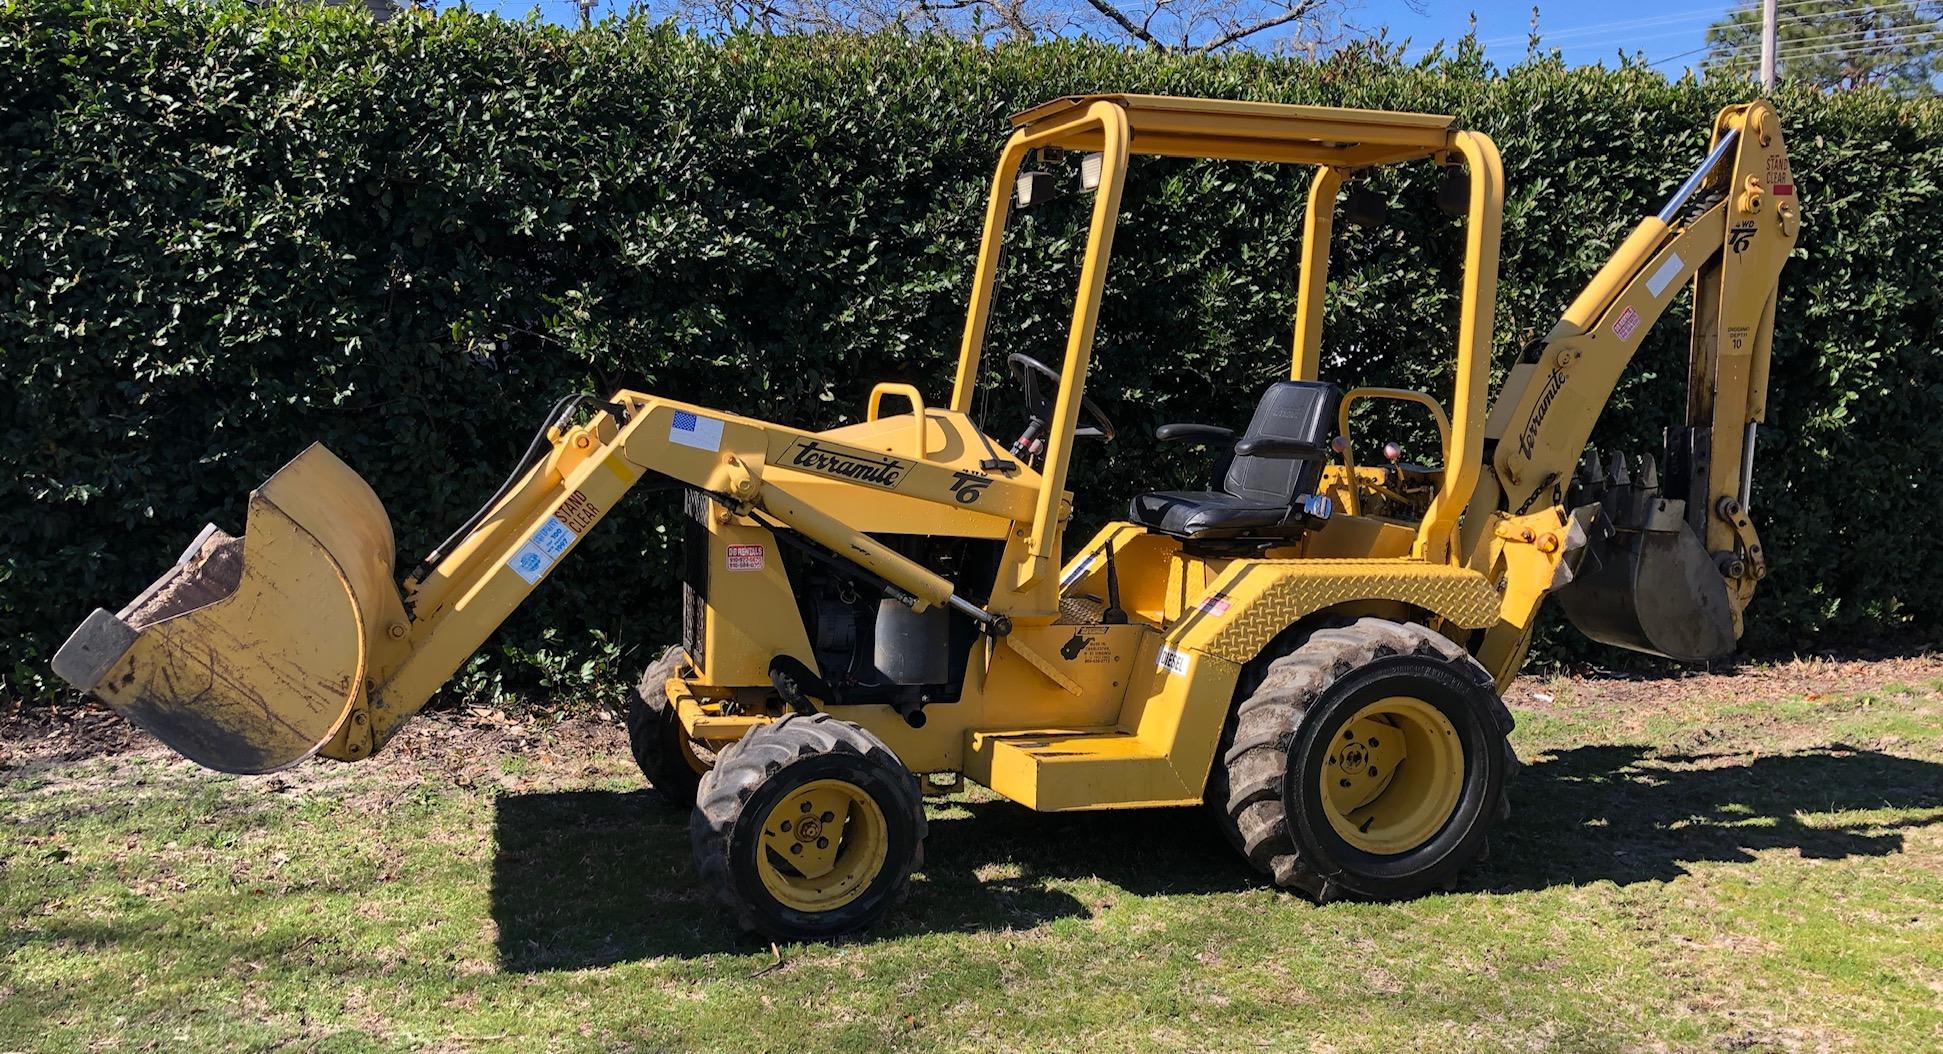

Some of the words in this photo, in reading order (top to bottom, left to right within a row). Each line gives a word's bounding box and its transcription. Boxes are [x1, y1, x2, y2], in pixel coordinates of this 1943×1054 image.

[1766, 158, 1788, 171] STAND
[1766, 171, 1786, 184] CLEAR
[1728, 228, 1758, 254] T6
[1732, 338, 1742, 349] 10
[1519, 367, 1566, 460] terramite
[793, 441, 904, 487] terramite
[949, 471, 994, 504] T6
[555, 490, 588, 524] STAND
[569, 503, 600, 534] CLEAR
[1161, 650, 1184, 672] DIESEL
